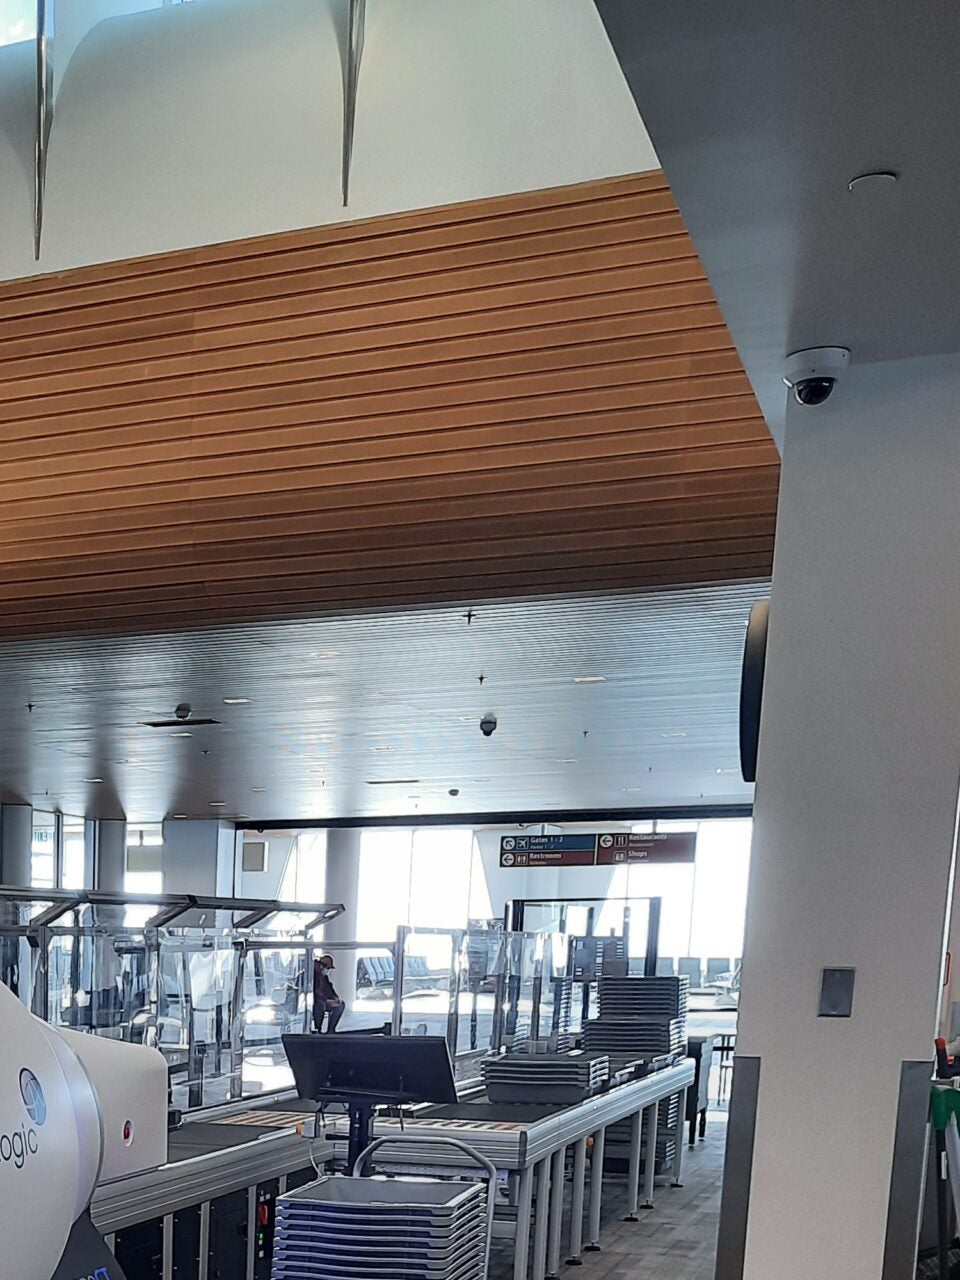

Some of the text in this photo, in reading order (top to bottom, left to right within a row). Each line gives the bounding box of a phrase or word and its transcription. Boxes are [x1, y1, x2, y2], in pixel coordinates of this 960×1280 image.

[530, 836, 548, 844] Gates
[530, 852, 562, 860] Restrooms
[628, 850, 648, 858] Shops
